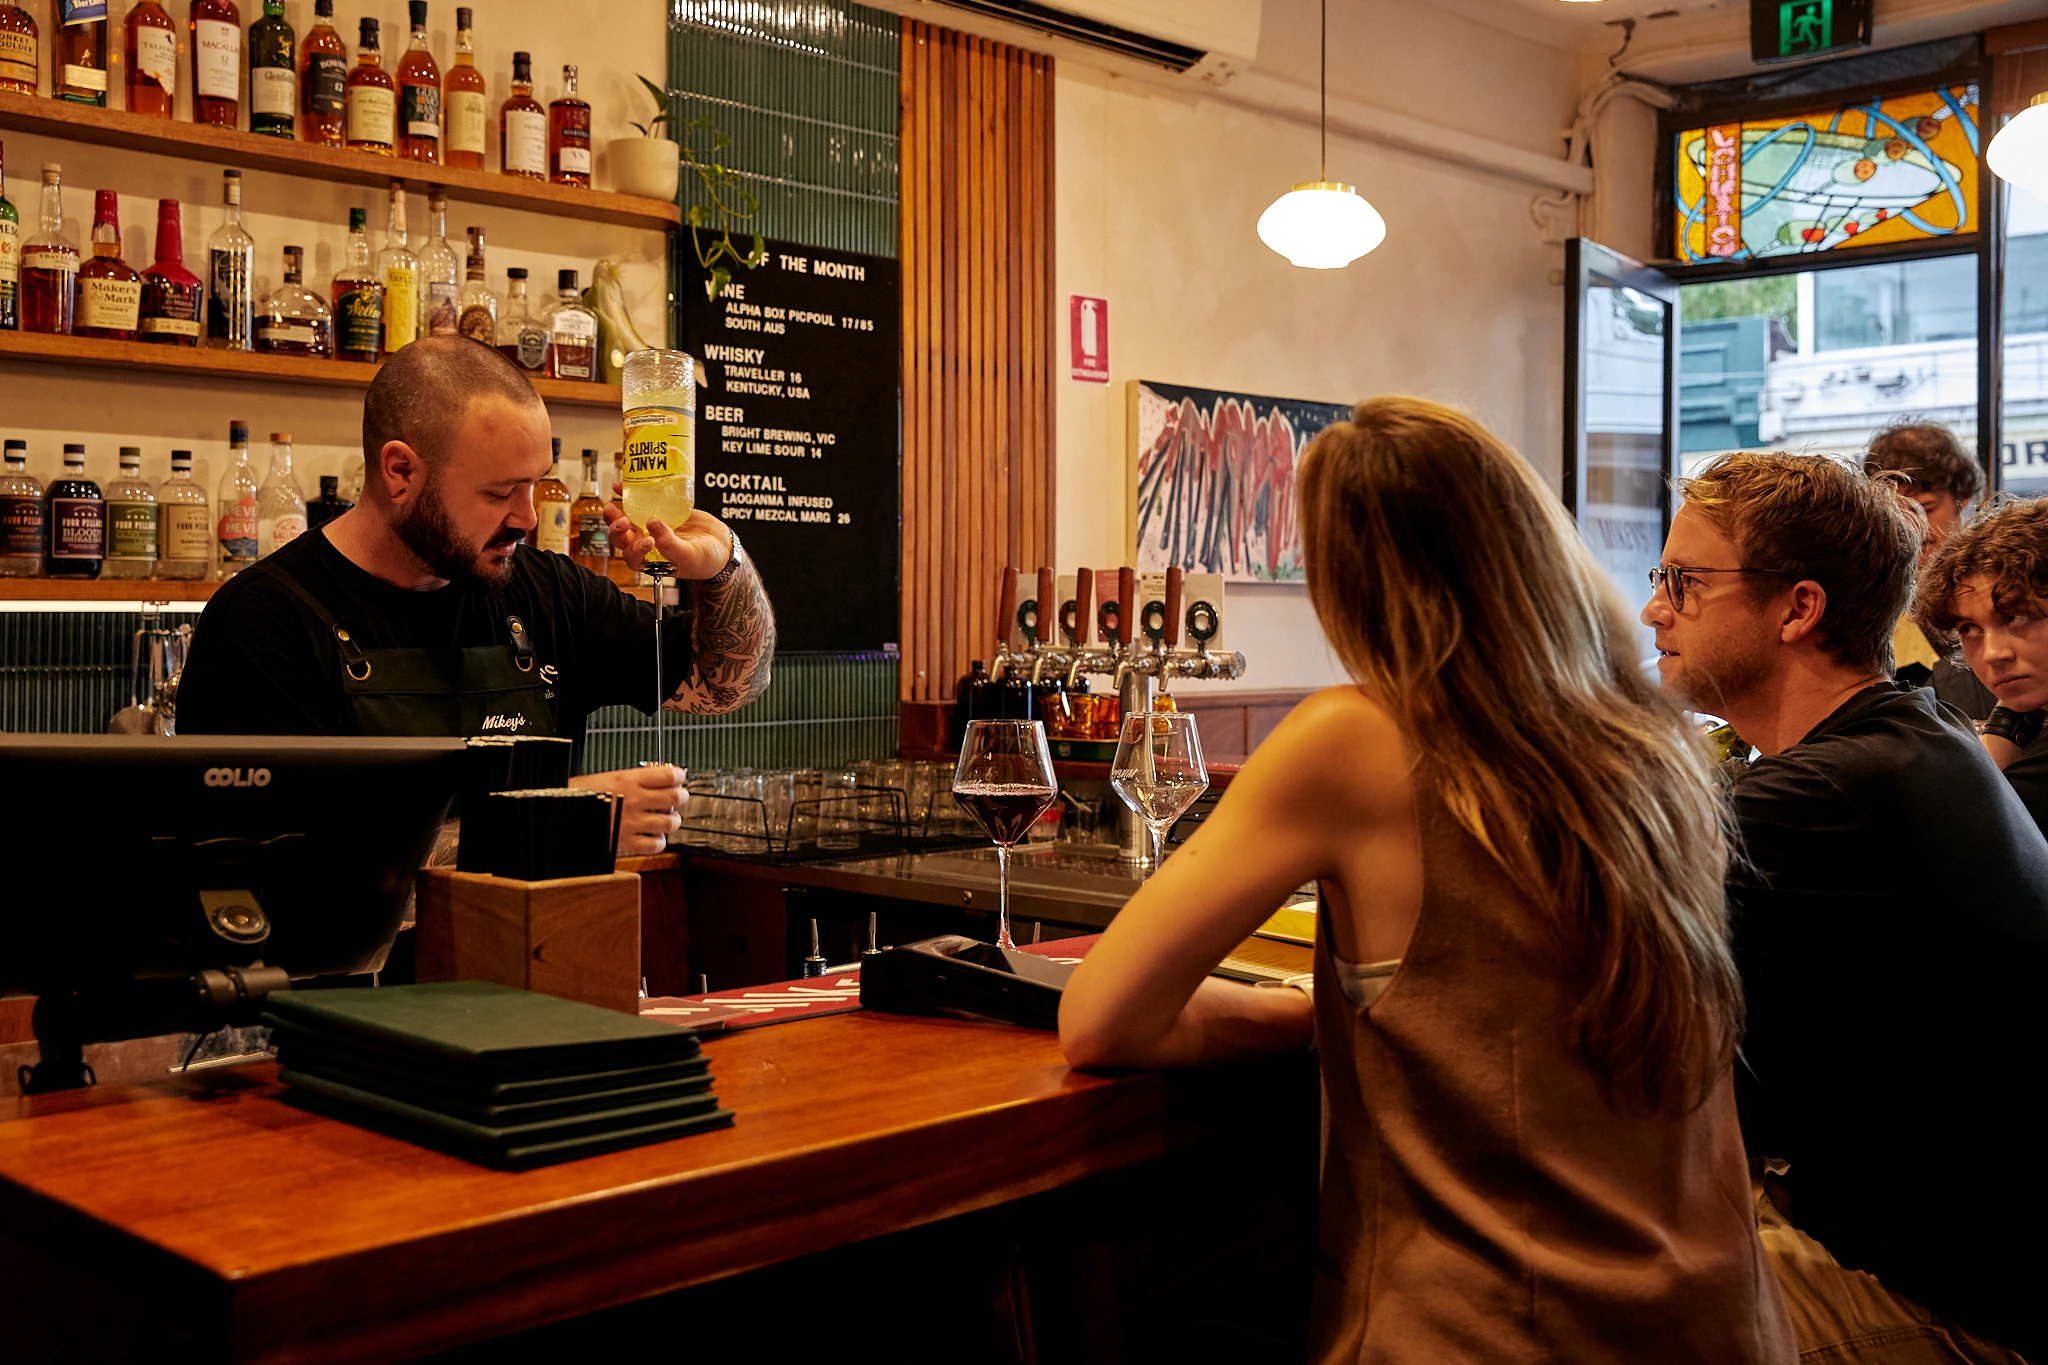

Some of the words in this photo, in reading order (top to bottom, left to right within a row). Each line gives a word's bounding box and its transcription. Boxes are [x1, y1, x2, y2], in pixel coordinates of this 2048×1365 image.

[779, 254, 808, 273] THE
[813, 260, 865, 281] MONTH
[105, 293, 137, 304] Mark
[704, 279, 745, 300] WNE
[725, 301, 762, 317] ALPHA
[763, 306, 786, 320] BOX
[788, 310, 836, 327] PICPOUL
[724, 316, 761, 332] SOUTH
[763, 321, 786, 335] AUS
[704, 343, 765, 365] WHISKY
[723, 364, 785, 382] TRAVELLER
[725, 380, 786, 398] KENTUCKY,
[787, 387, 810, 400] USA
[704, 404, 745, 424] BEER
[721, 425, 761, 439] BRIGHT
[763, 428, 816, 445] BREWING,
[816, 433, 836, 446] VIC
[629, 441, 667, 457] SPIRITS
[721, 440, 744, 453] KEY
[746, 442, 772, 455] LIME
[773, 446, 805, 457] SOUR
[810, 447, 822, 460] 14
[629, 456, 667, 473] MANLY
[704, 472, 787, 492] COCKTAIL
[722, 492, 785, 507] LAOGANMA
[787, 495, 833, 509] INFUSED
[62, 518, 80, 526] FOUR
[721, 507, 753, 520] SPICY
[755, 509, 799, 522] MEZCAL
[800, 511, 831, 523] MARG
[115, 521, 133, 530] FOUR
[482, 712, 526, 732] Mikey's
